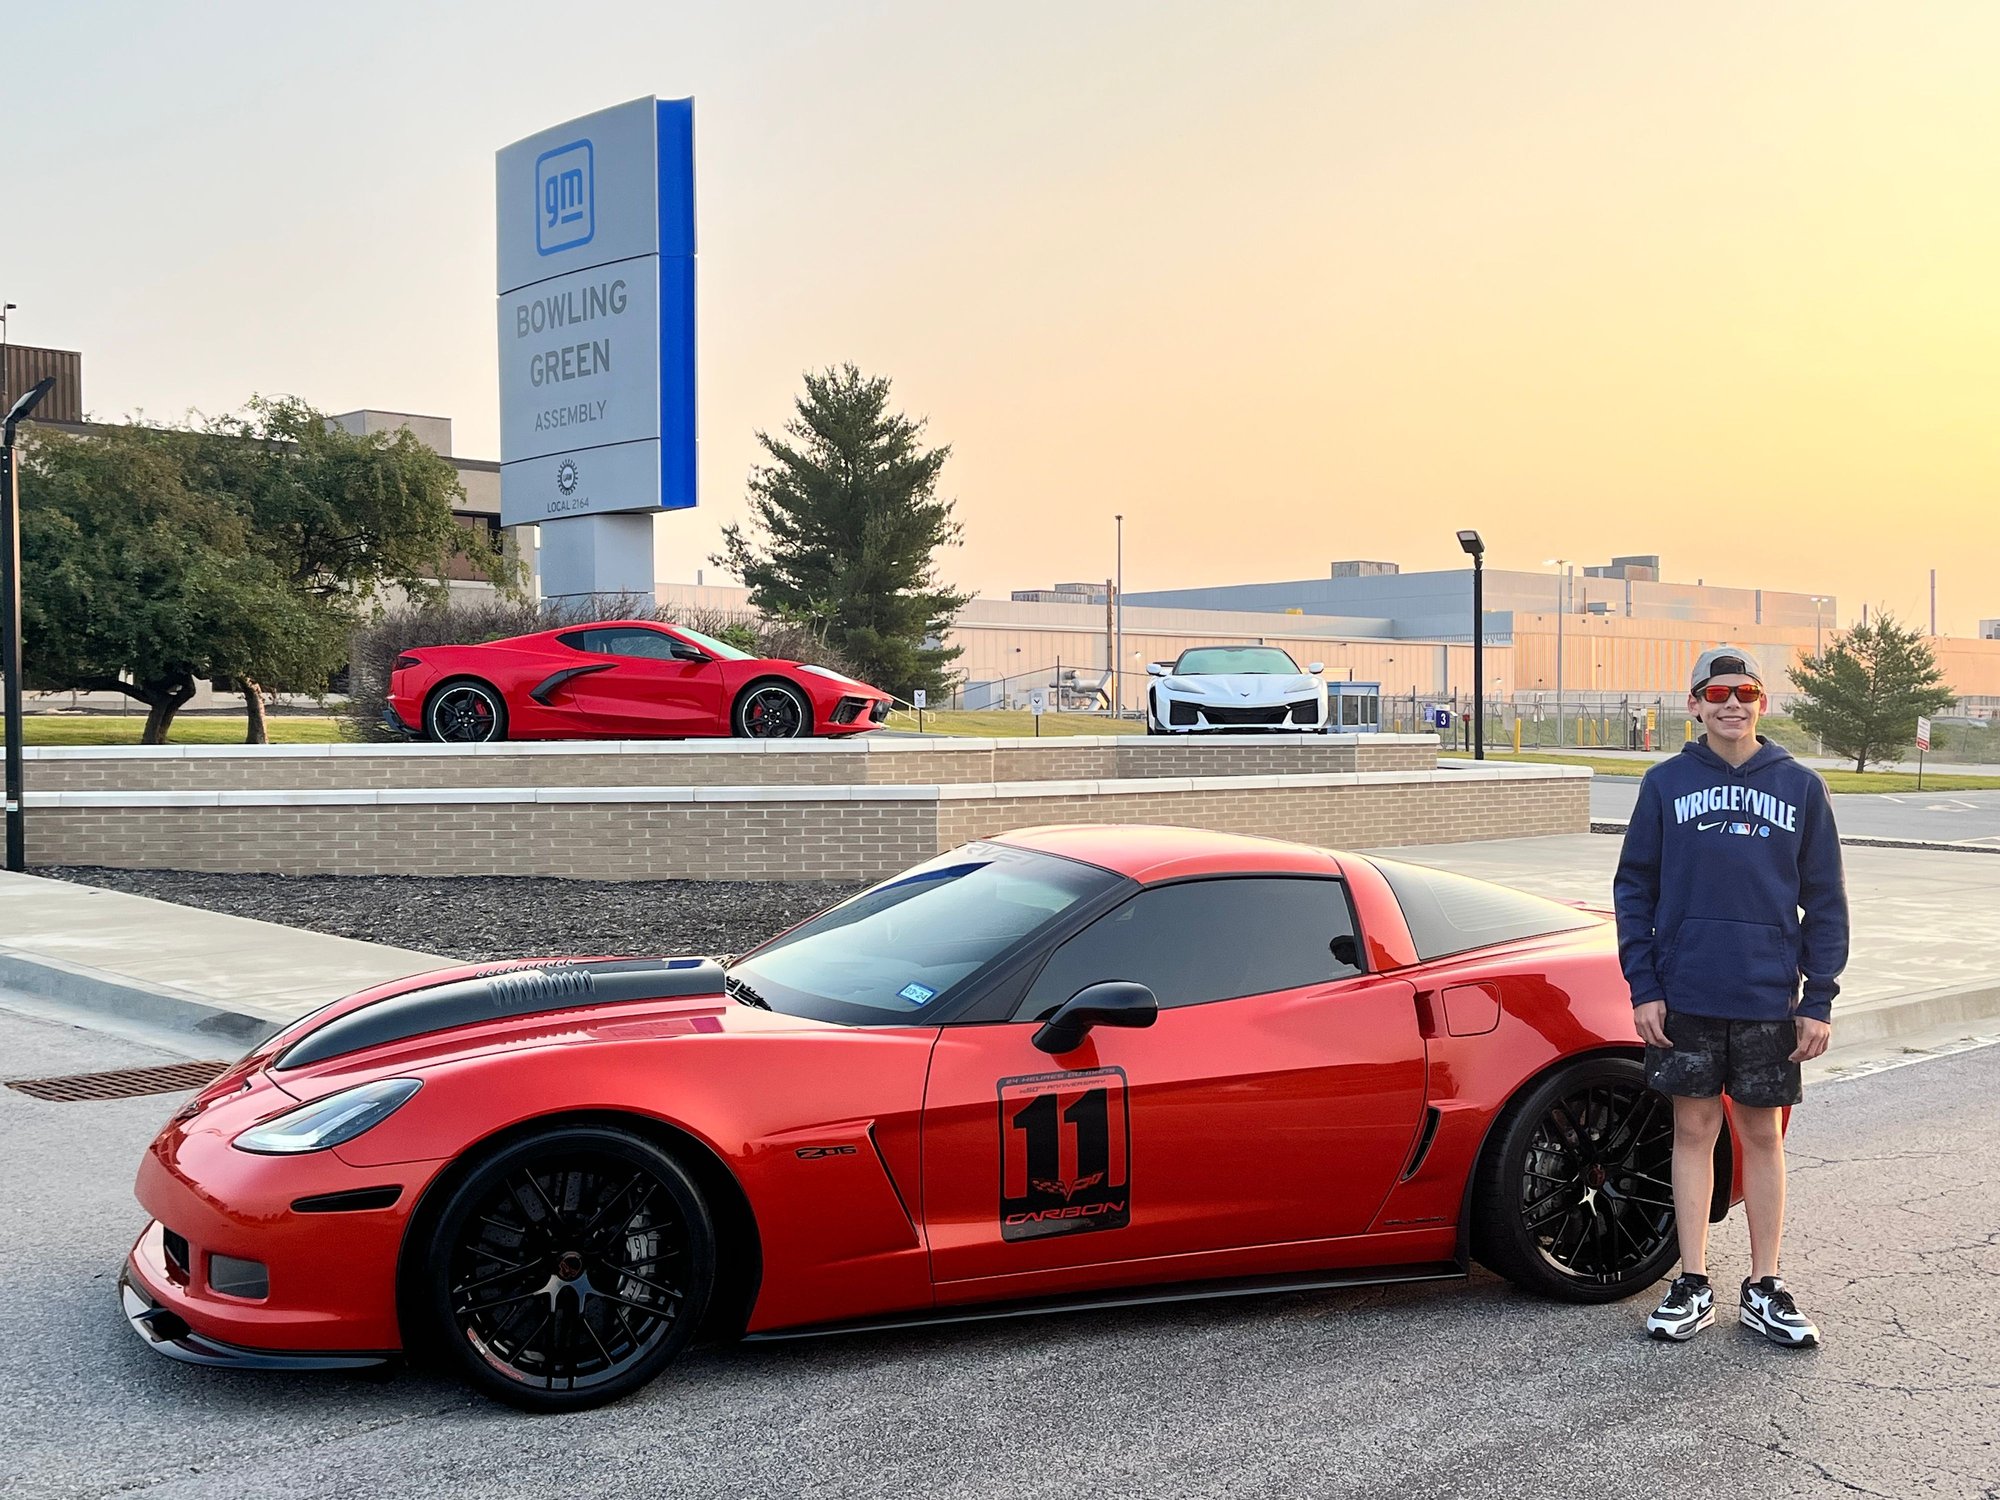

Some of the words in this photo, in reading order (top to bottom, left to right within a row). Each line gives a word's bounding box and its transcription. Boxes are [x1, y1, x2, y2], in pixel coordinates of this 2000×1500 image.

[545, 168, 583, 228] gm
[516, 279, 627, 338] BOWLING
[530, 338, 610, 387] GREEN
[534, 400, 607, 432] ASSEMBLY
[547, 500, 571, 513] LOCAL
[571, 497, 590, 510] 2164
[1440, 712, 1447, 726] 3
[1673, 785, 1797, 833] WRIGLEYVILLE
[1012, 1087, 1109, 1194] 11
[1004, 1200, 1126, 1227] CARBON
